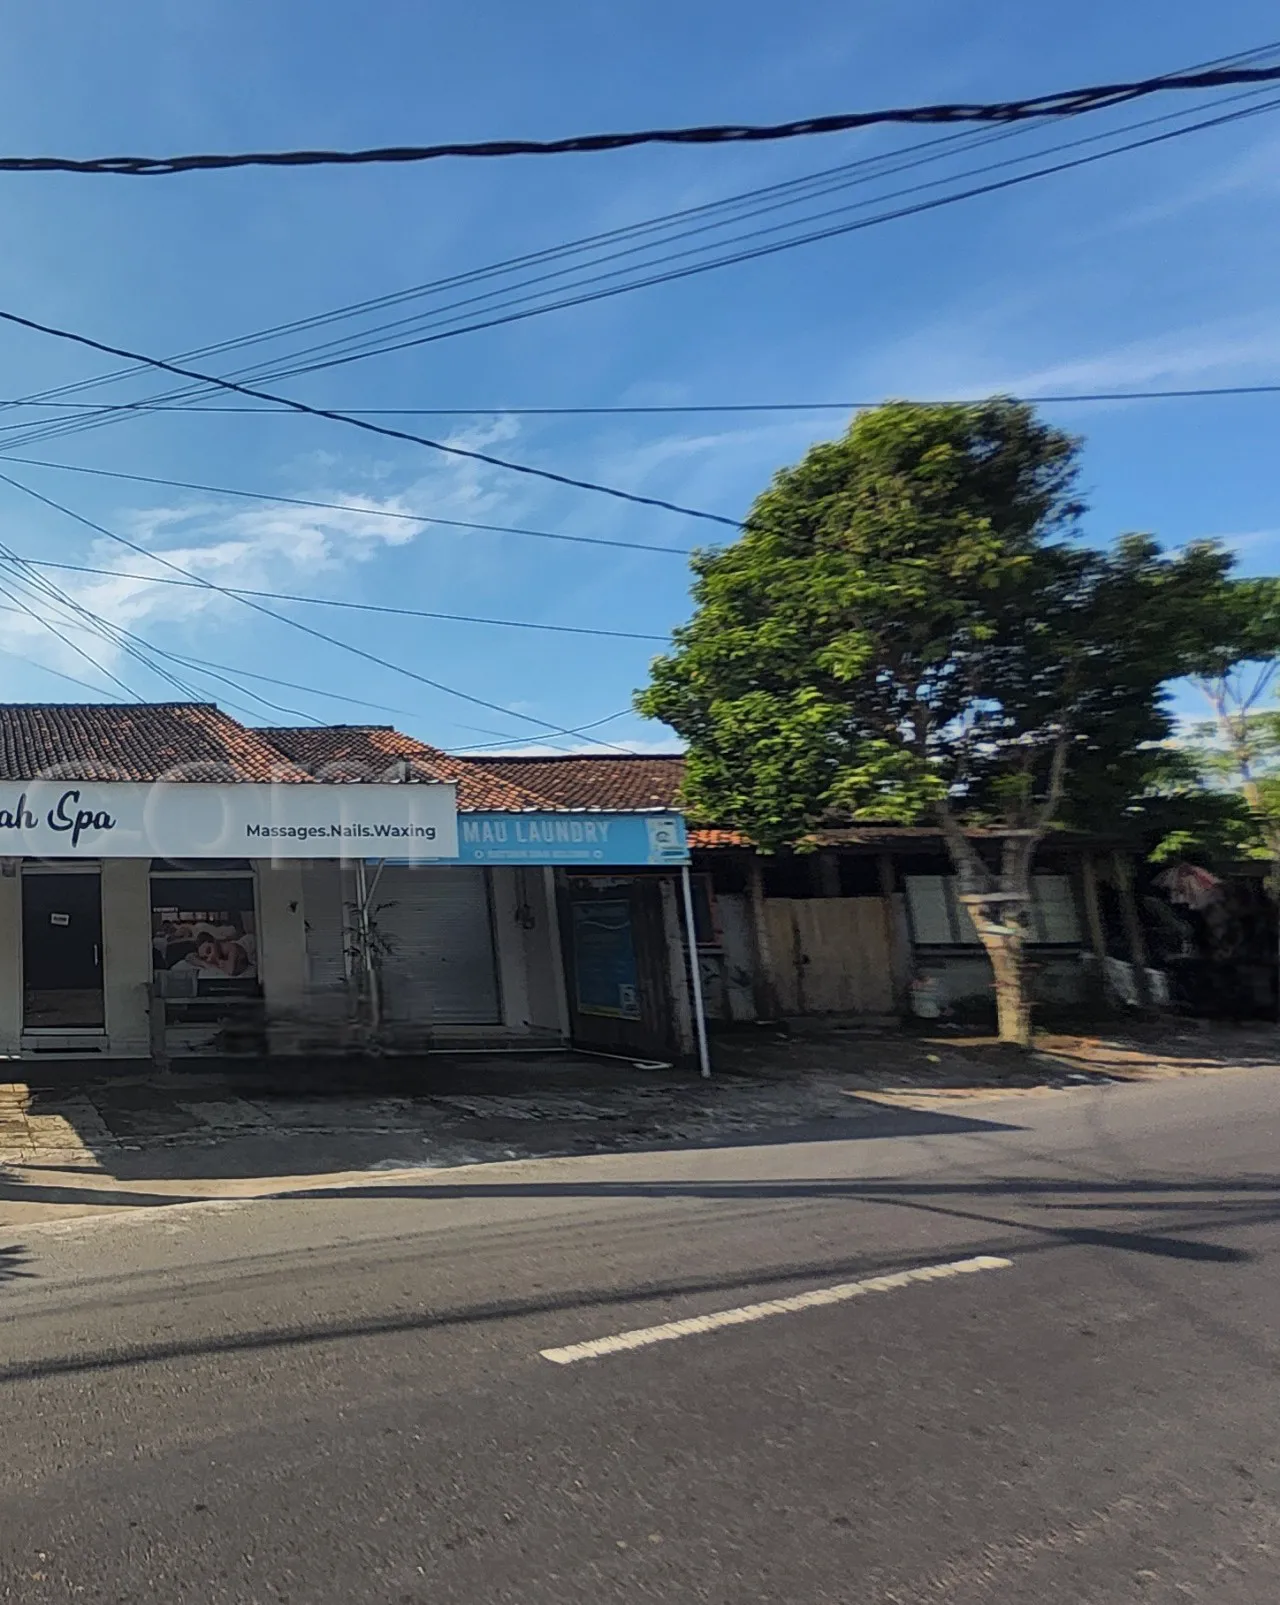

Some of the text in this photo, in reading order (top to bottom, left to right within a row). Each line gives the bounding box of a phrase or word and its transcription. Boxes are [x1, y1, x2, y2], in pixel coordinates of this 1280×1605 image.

[47, 790, 117, 848] Spa
[246, 824, 436, 840] Massages.Nails.Waxing
[515, 821, 609, 843] LAUNDRY
